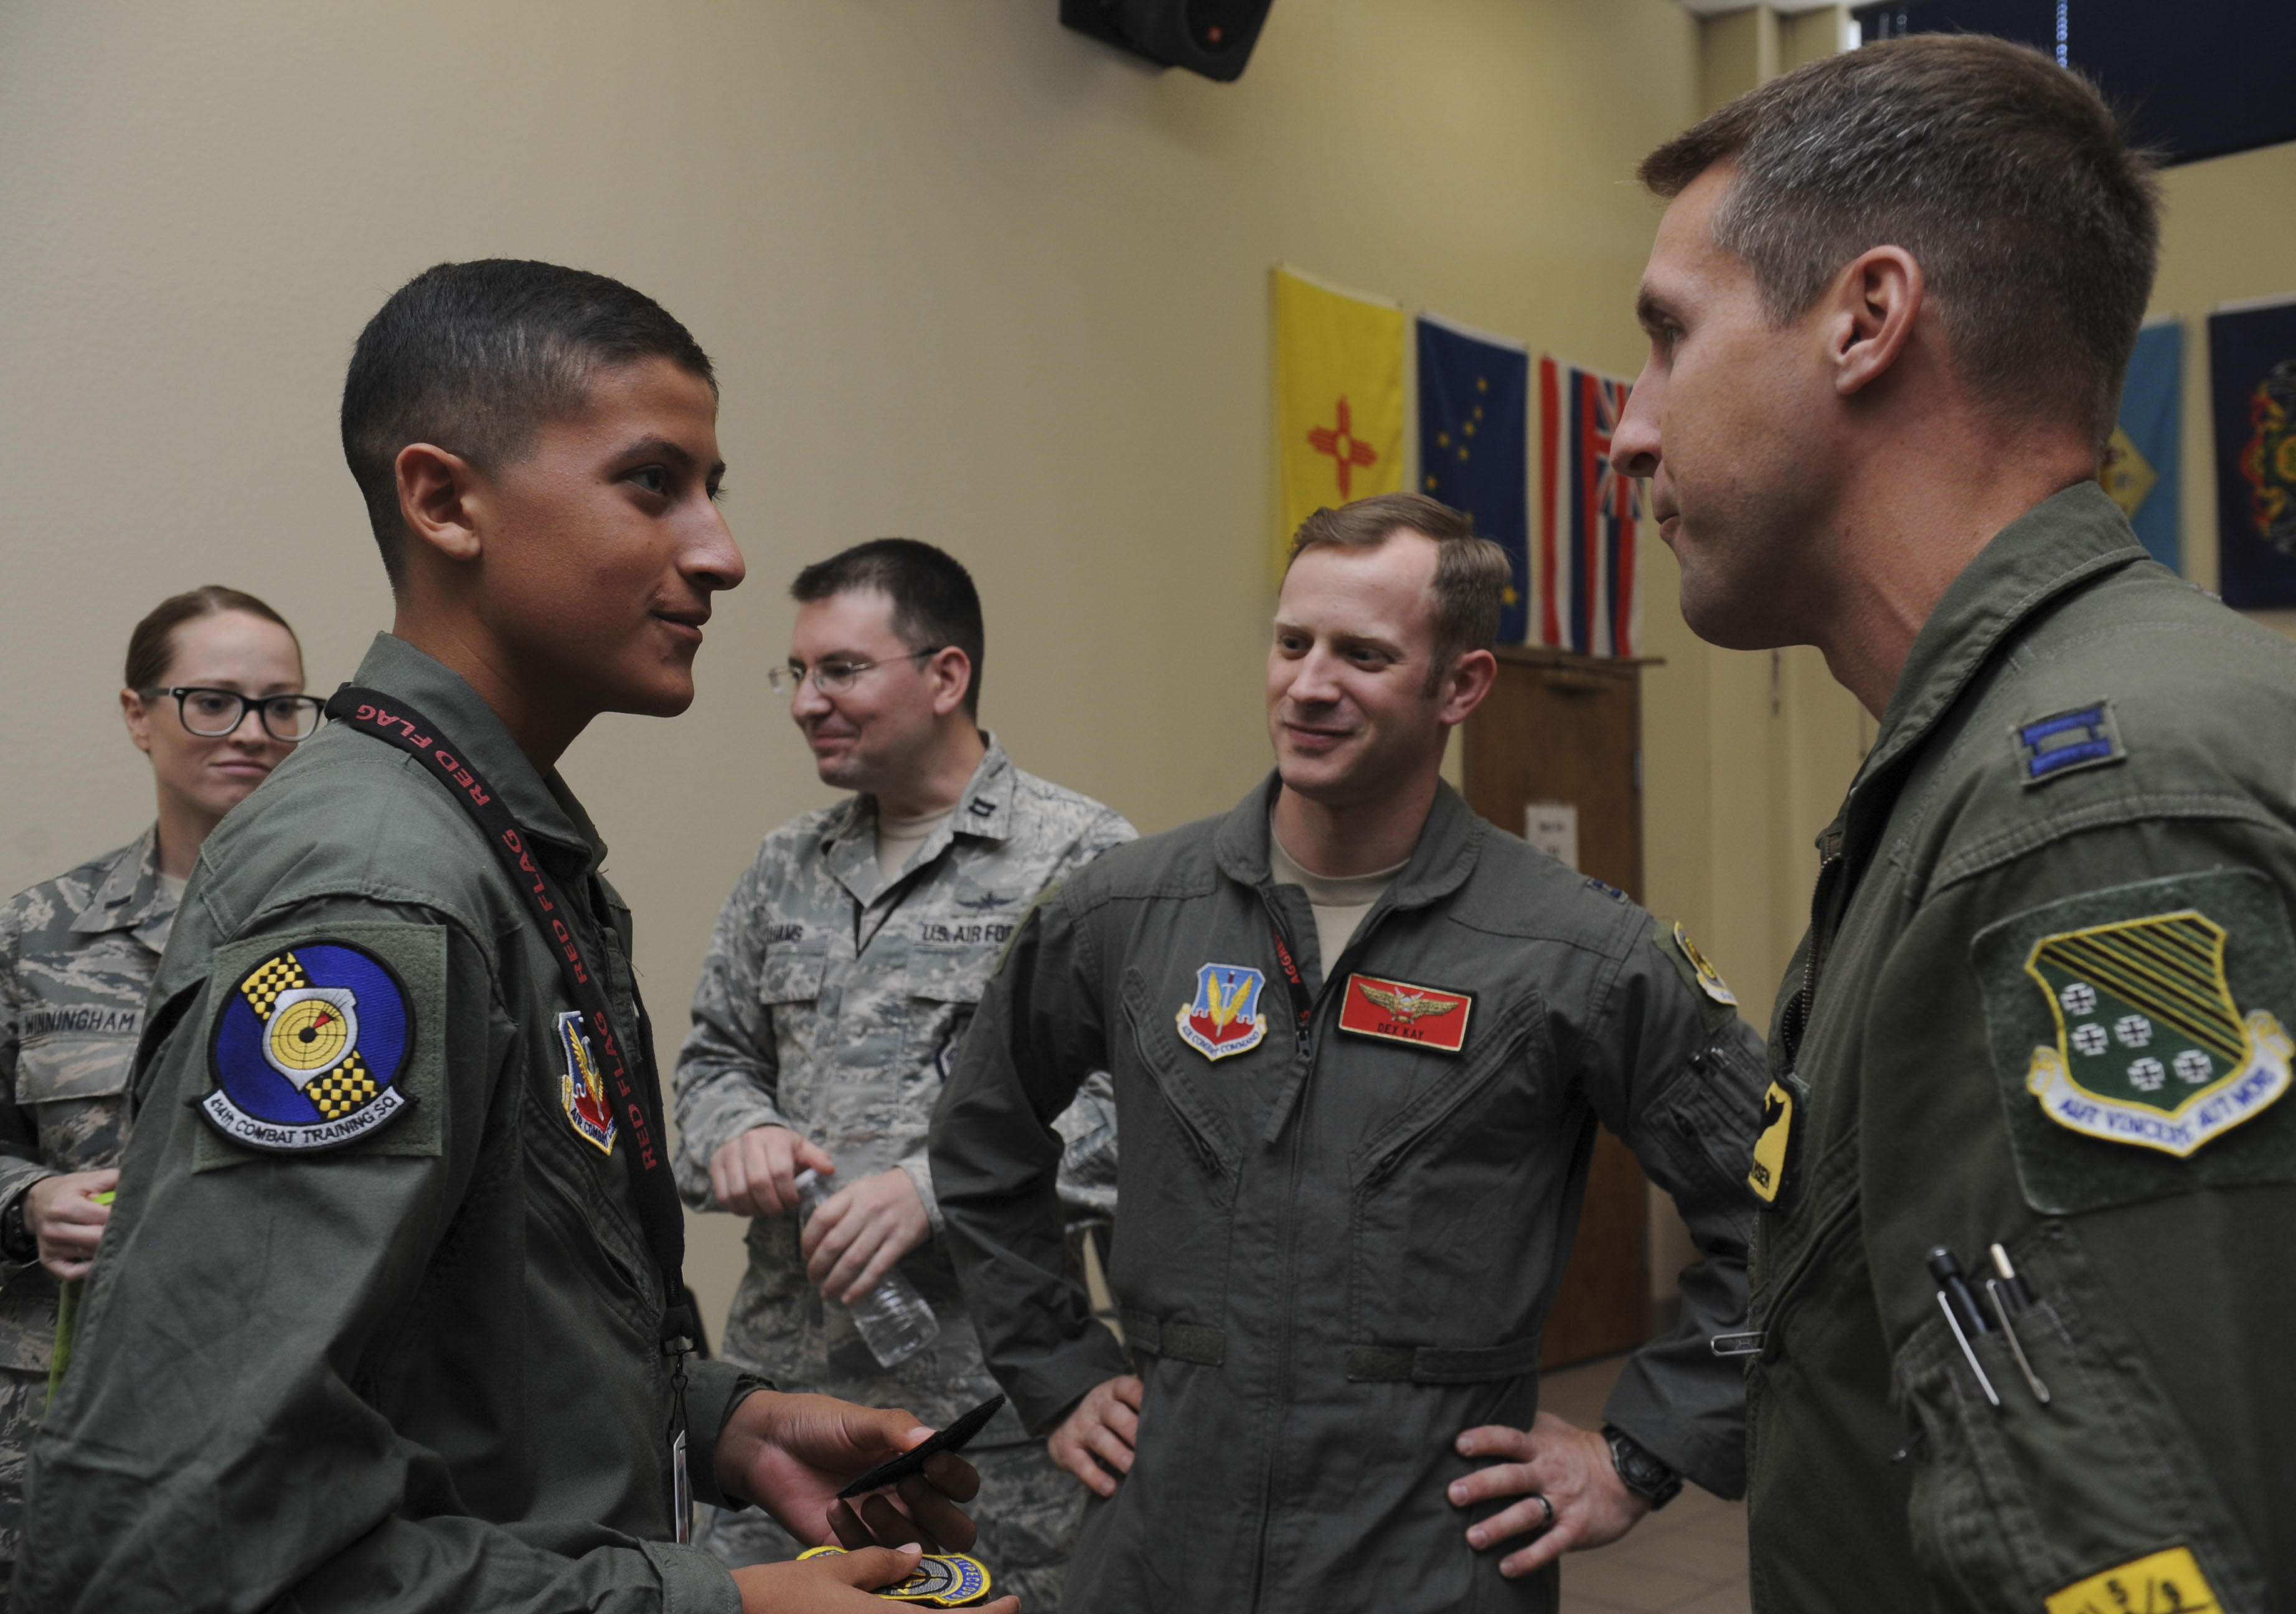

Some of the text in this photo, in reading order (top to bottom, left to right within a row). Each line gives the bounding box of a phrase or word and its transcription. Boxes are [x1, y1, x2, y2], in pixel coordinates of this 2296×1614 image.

[355, 704, 491, 806] RED FLAG
[502, 829, 588, 984] RED FLAG
[952, 924, 982, 942] AIR
[1220, 1031, 1259, 1054] COMMAND
[593, 1011, 657, 1171] RED FLAG
[235, 1120, 296, 1144] COMBAT
[303, 1111, 376, 1144] TRAINING
[374, 1095, 397, 1119] SQ
[570, 1107, 582, 1128] AIR
[584, 1121, 609, 1149] COMBAT
